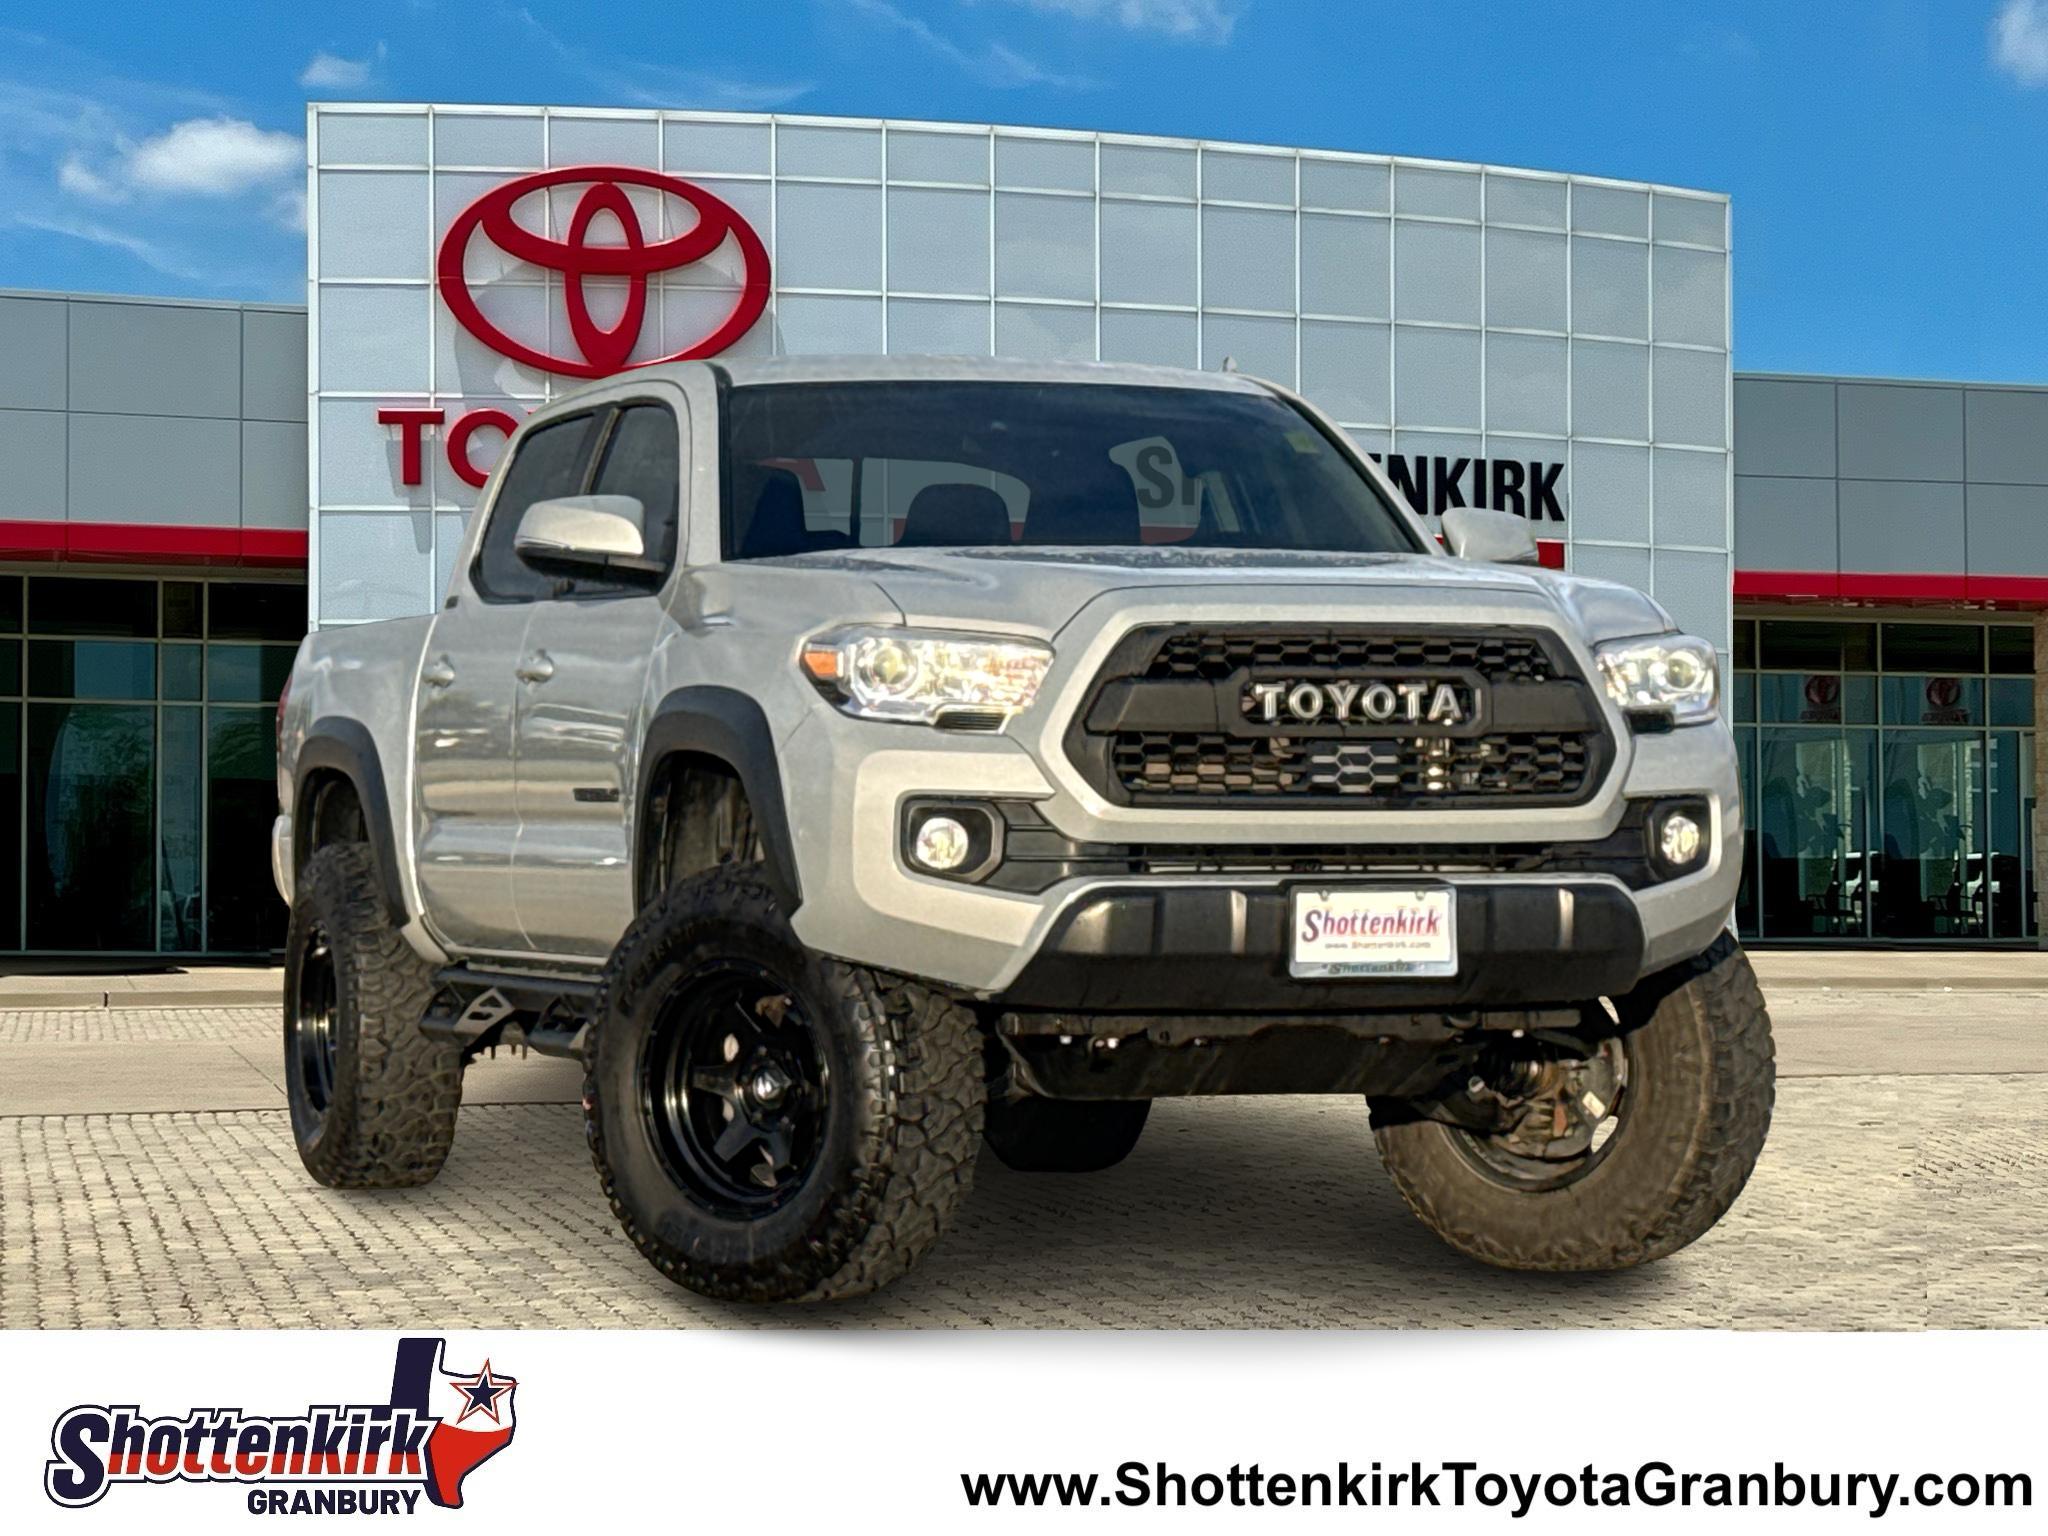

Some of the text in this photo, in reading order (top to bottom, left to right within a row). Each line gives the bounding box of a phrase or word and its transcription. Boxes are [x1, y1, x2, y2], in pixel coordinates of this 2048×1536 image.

[1368, 453, 1566, 521] NKIRK
[1255, 682, 1462, 720] TOYOTA
[1302, 909, 1439, 942] Shottenkirk
